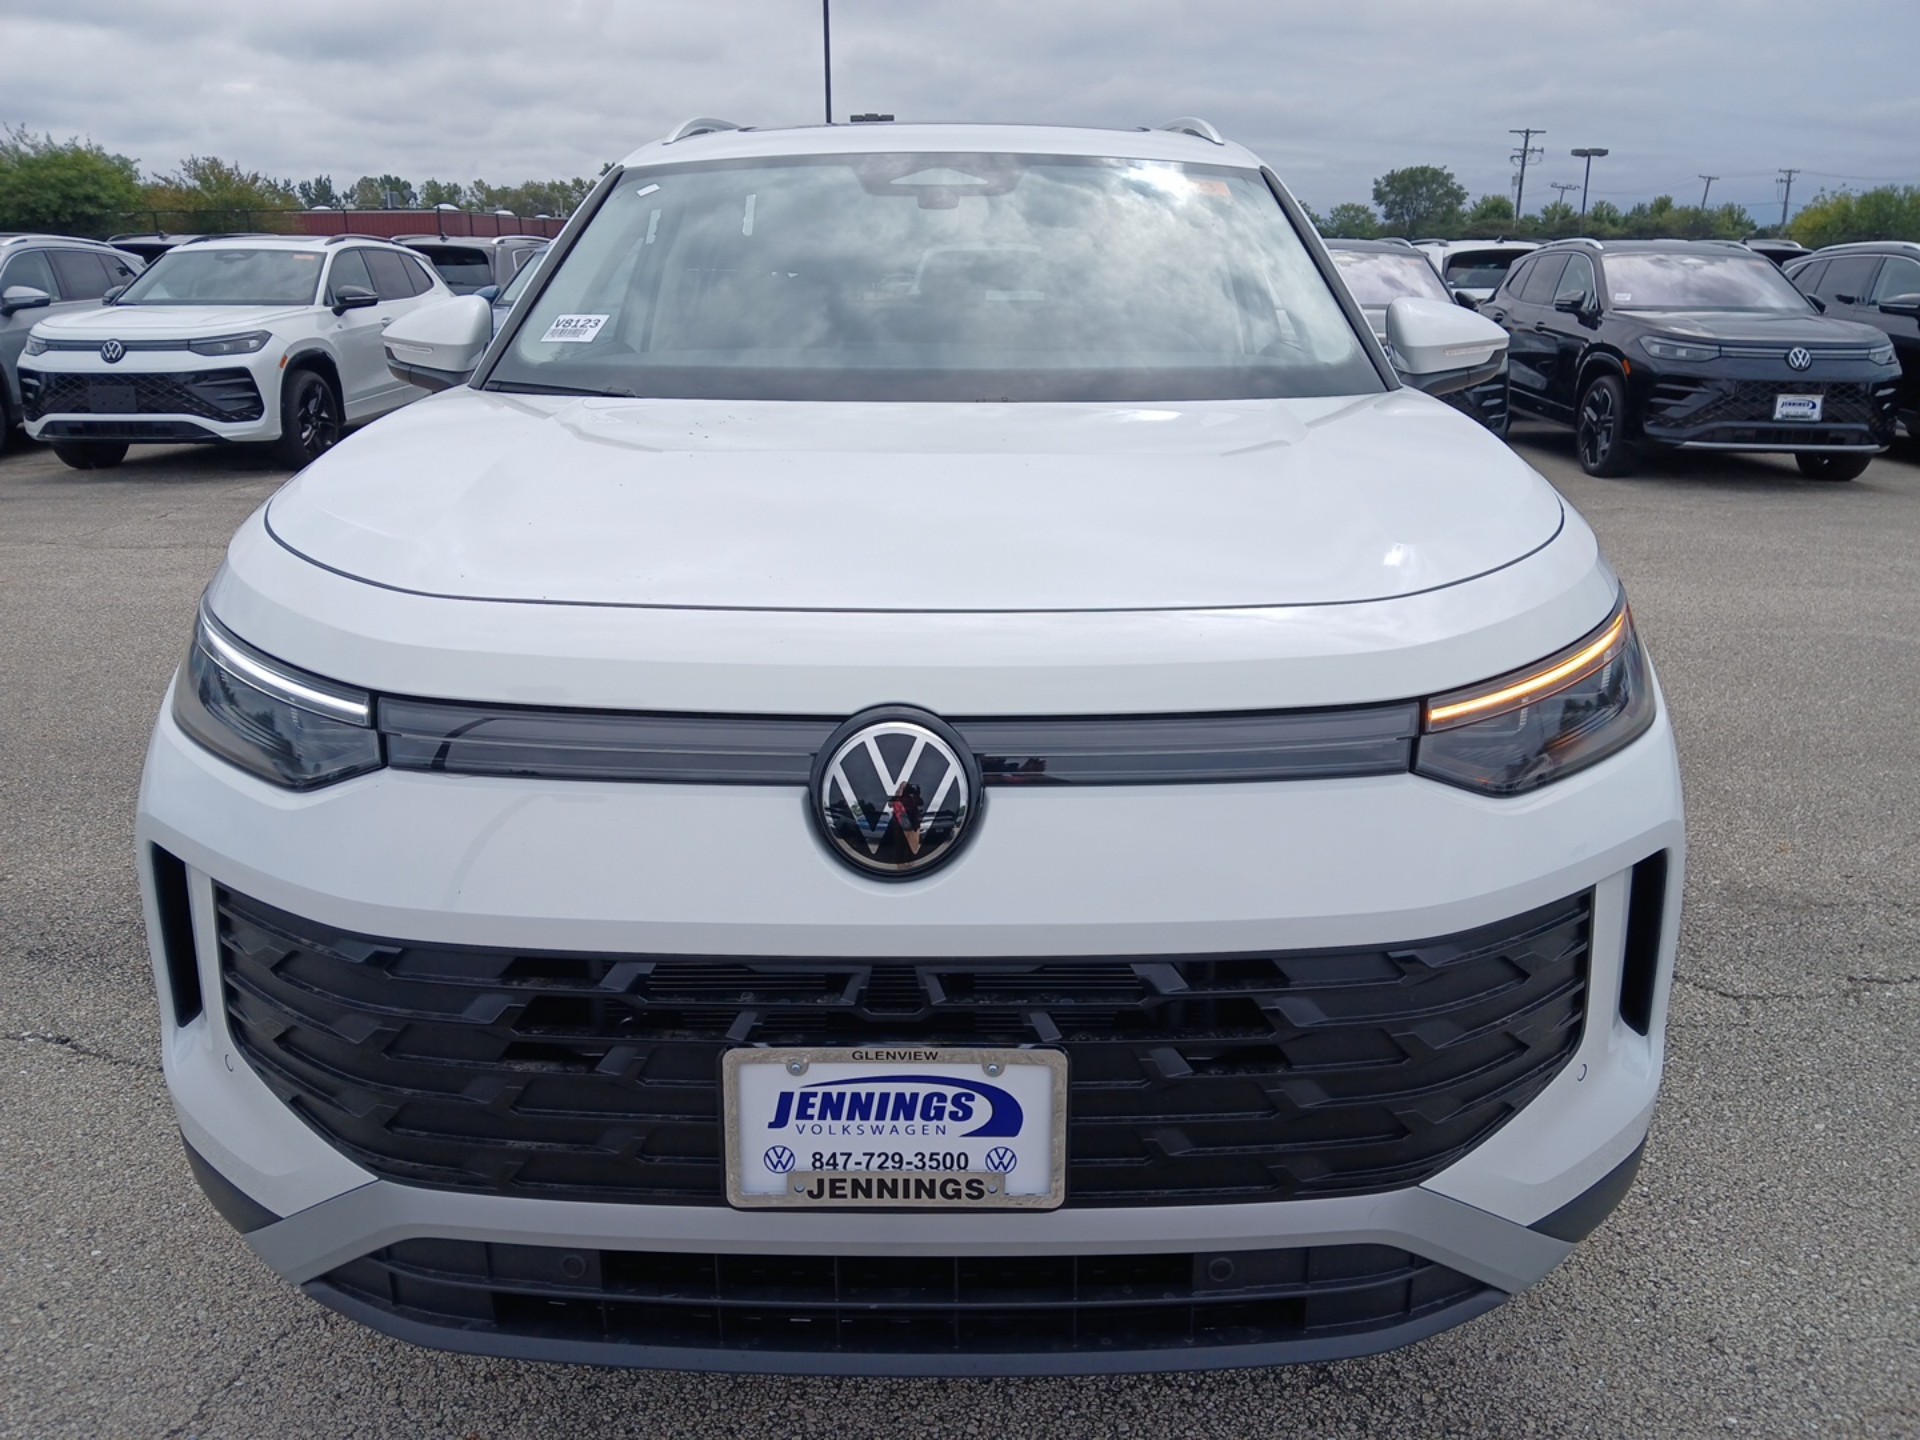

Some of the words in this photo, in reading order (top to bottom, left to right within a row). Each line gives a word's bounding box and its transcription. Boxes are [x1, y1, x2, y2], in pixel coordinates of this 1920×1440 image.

[851, 1050, 939, 1061] GLENVIEW
[767, 1091, 975, 1129] JENNINGS
[796, 1124, 946, 1136] VOLKSWAGEN
[811, 1152, 969, 1171] 847-729-3500
[807, 1178, 985, 1200] JENNINGS
